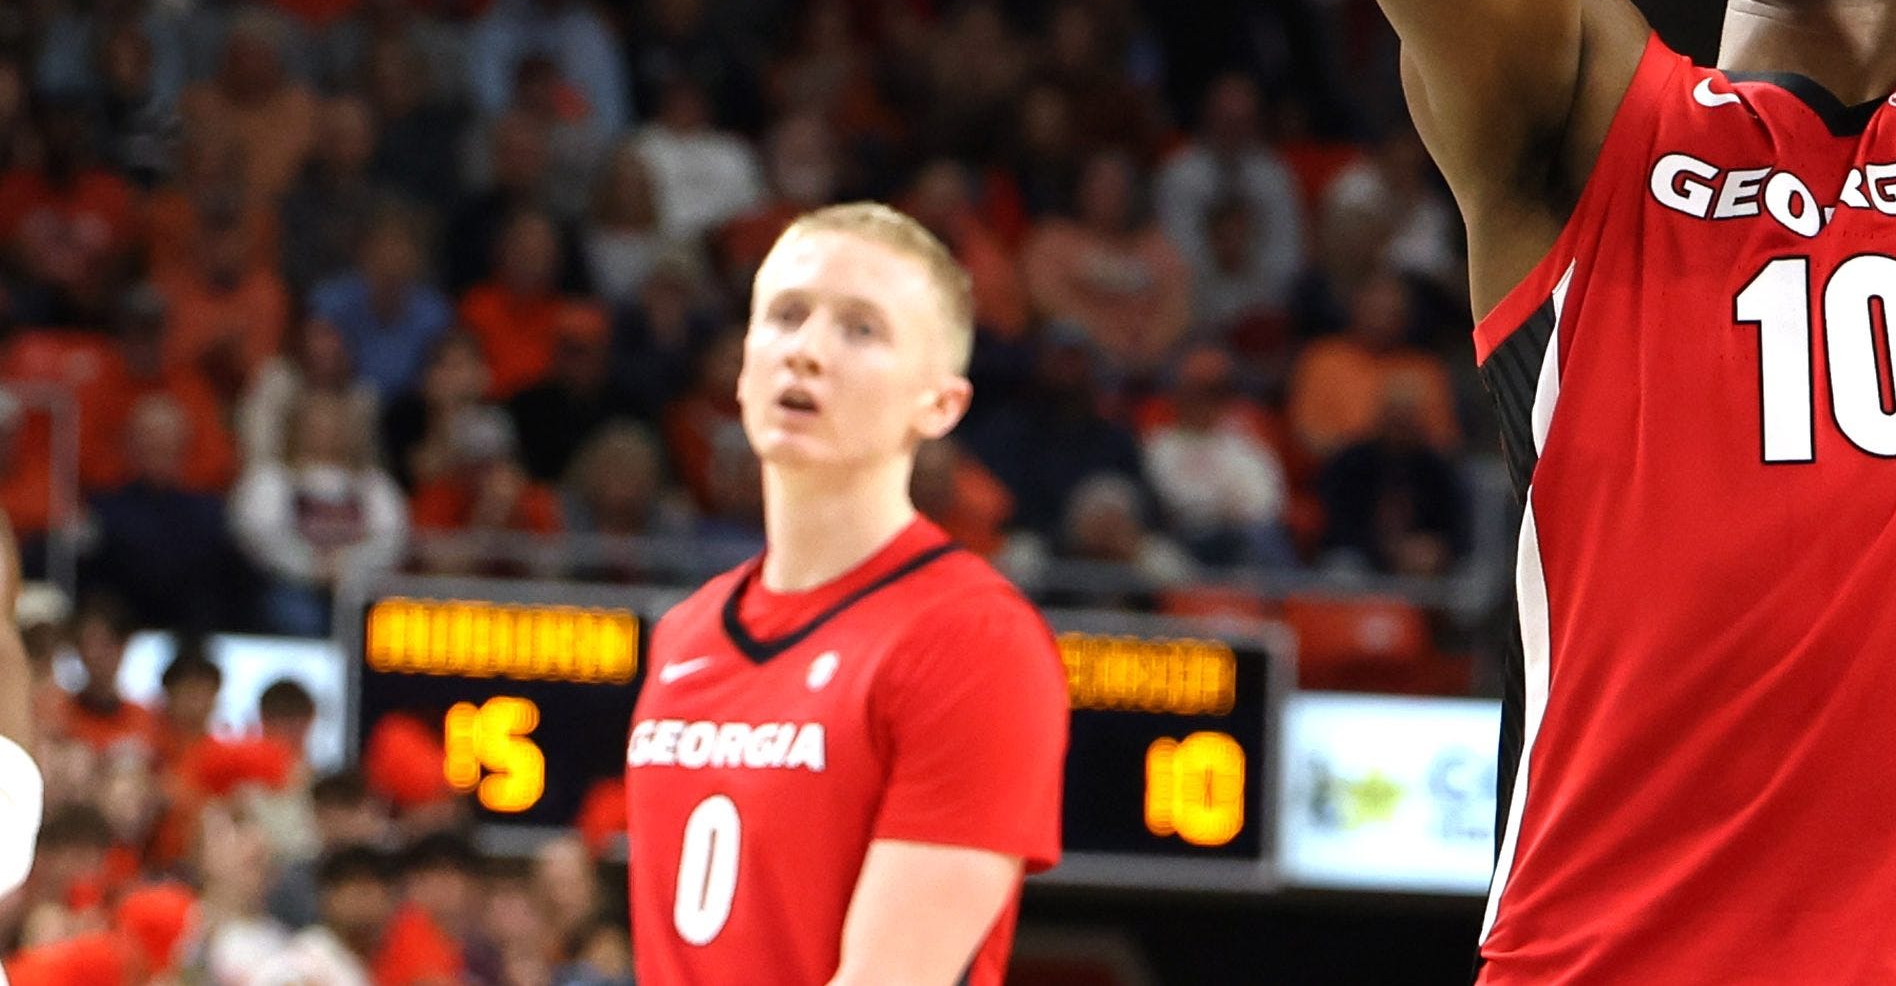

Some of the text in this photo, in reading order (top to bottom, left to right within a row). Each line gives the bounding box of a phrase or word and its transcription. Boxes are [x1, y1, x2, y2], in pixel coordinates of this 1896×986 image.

[627, 718, 826, 773] GEORGIA
[1145, 730, 1246, 846] 10
[673, 794, 742, 945] 0
